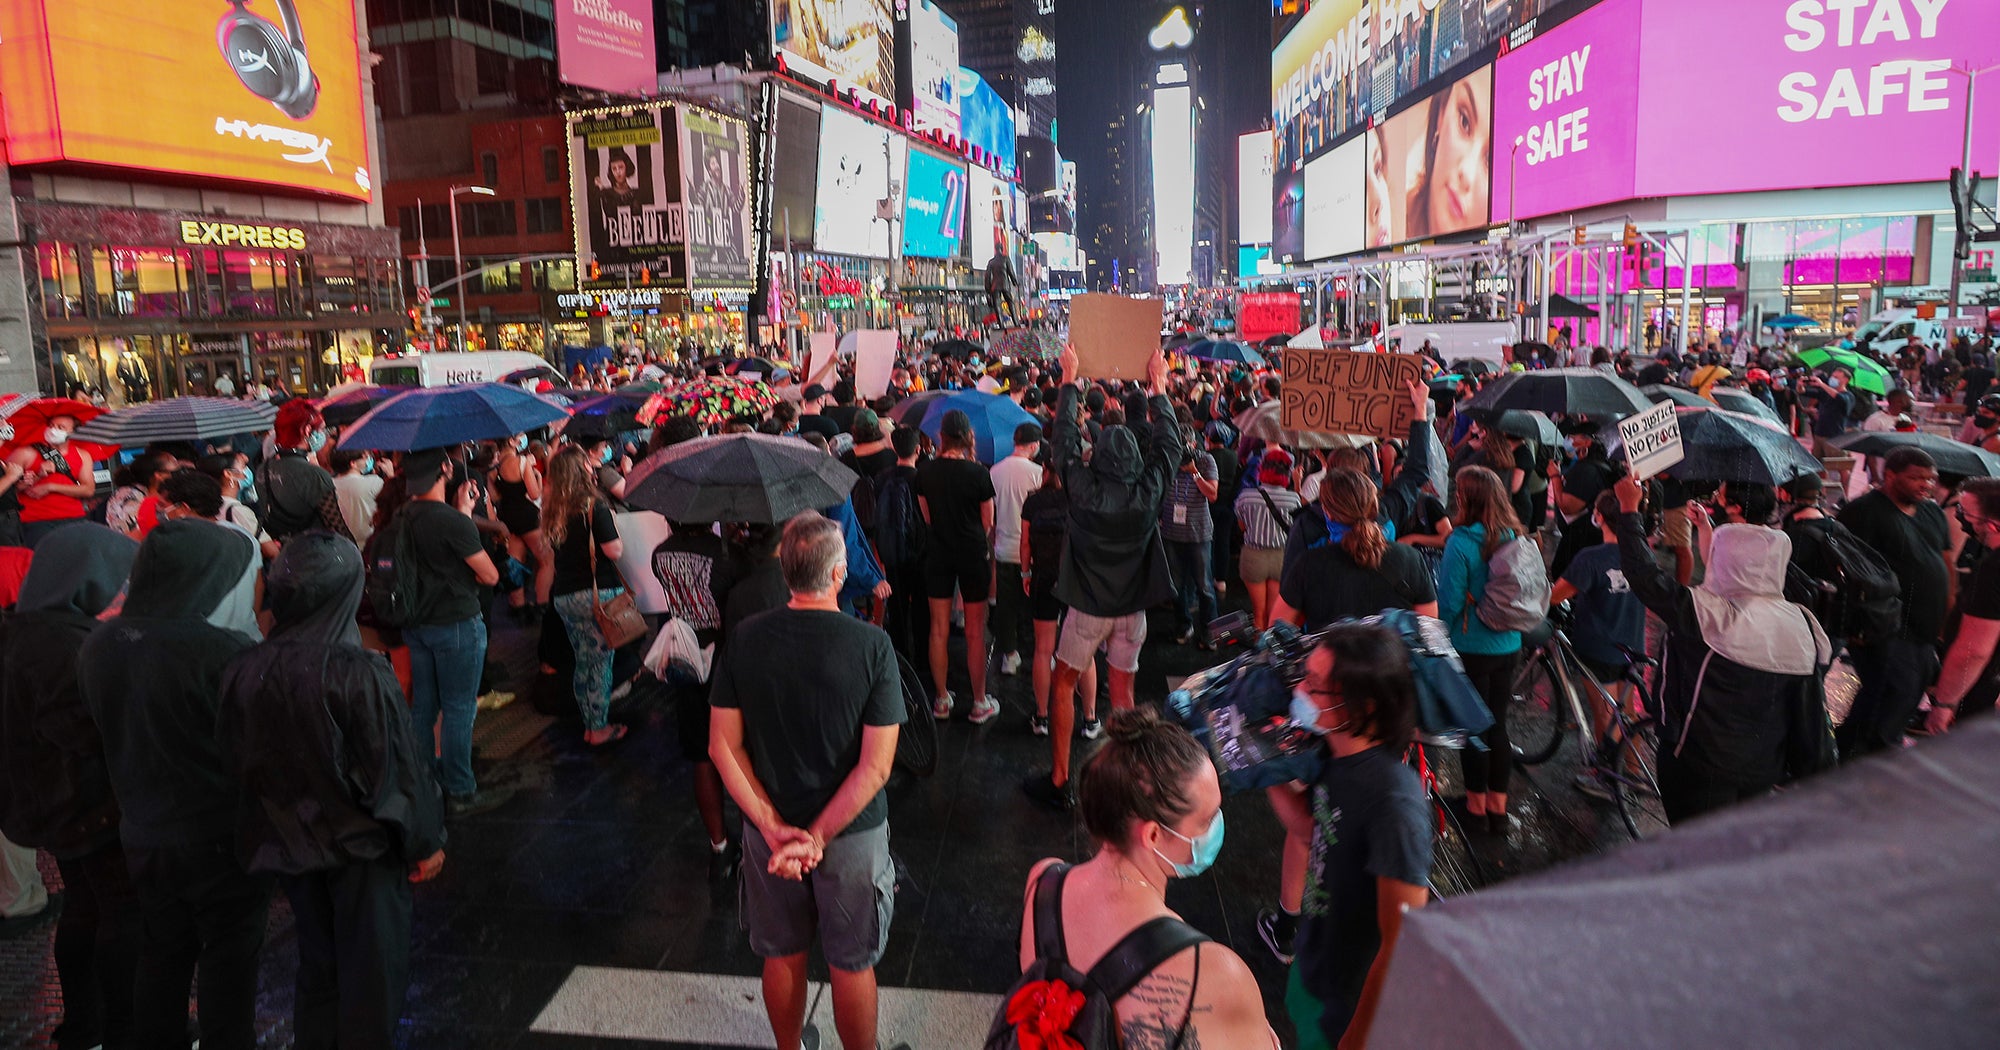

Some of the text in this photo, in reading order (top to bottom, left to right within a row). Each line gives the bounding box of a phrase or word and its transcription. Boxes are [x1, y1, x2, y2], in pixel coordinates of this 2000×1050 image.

[573, 0, 643, 33] Doubtfire
[1510, 18, 1537, 41] MARRIOTT
[1784, 0, 1949, 52] STAY
[1510, 29, 1534, 51] MARQUIS
[1277, 0, 1440, 127] WELCOME BA
[1528, 45, 1591, 111] STAY
[1777, 59, 1950, 123] SAFE
[1526, 107, 1589, 166] SAFE
[181, 220, 306, 250] EXPRESS
[557, 293, 594, 308] GIFTS
[267, 338, 312, 349] EXPRESS
[446, 369, 482, 385] Hertz
[1284, 350, 1421, 391] DEFUND
[1283, 388, 1416, 437] POLICE
[1622, 403, 1675, 440] NO JUSTICE
[1628, 439, 1645, 459] NO
